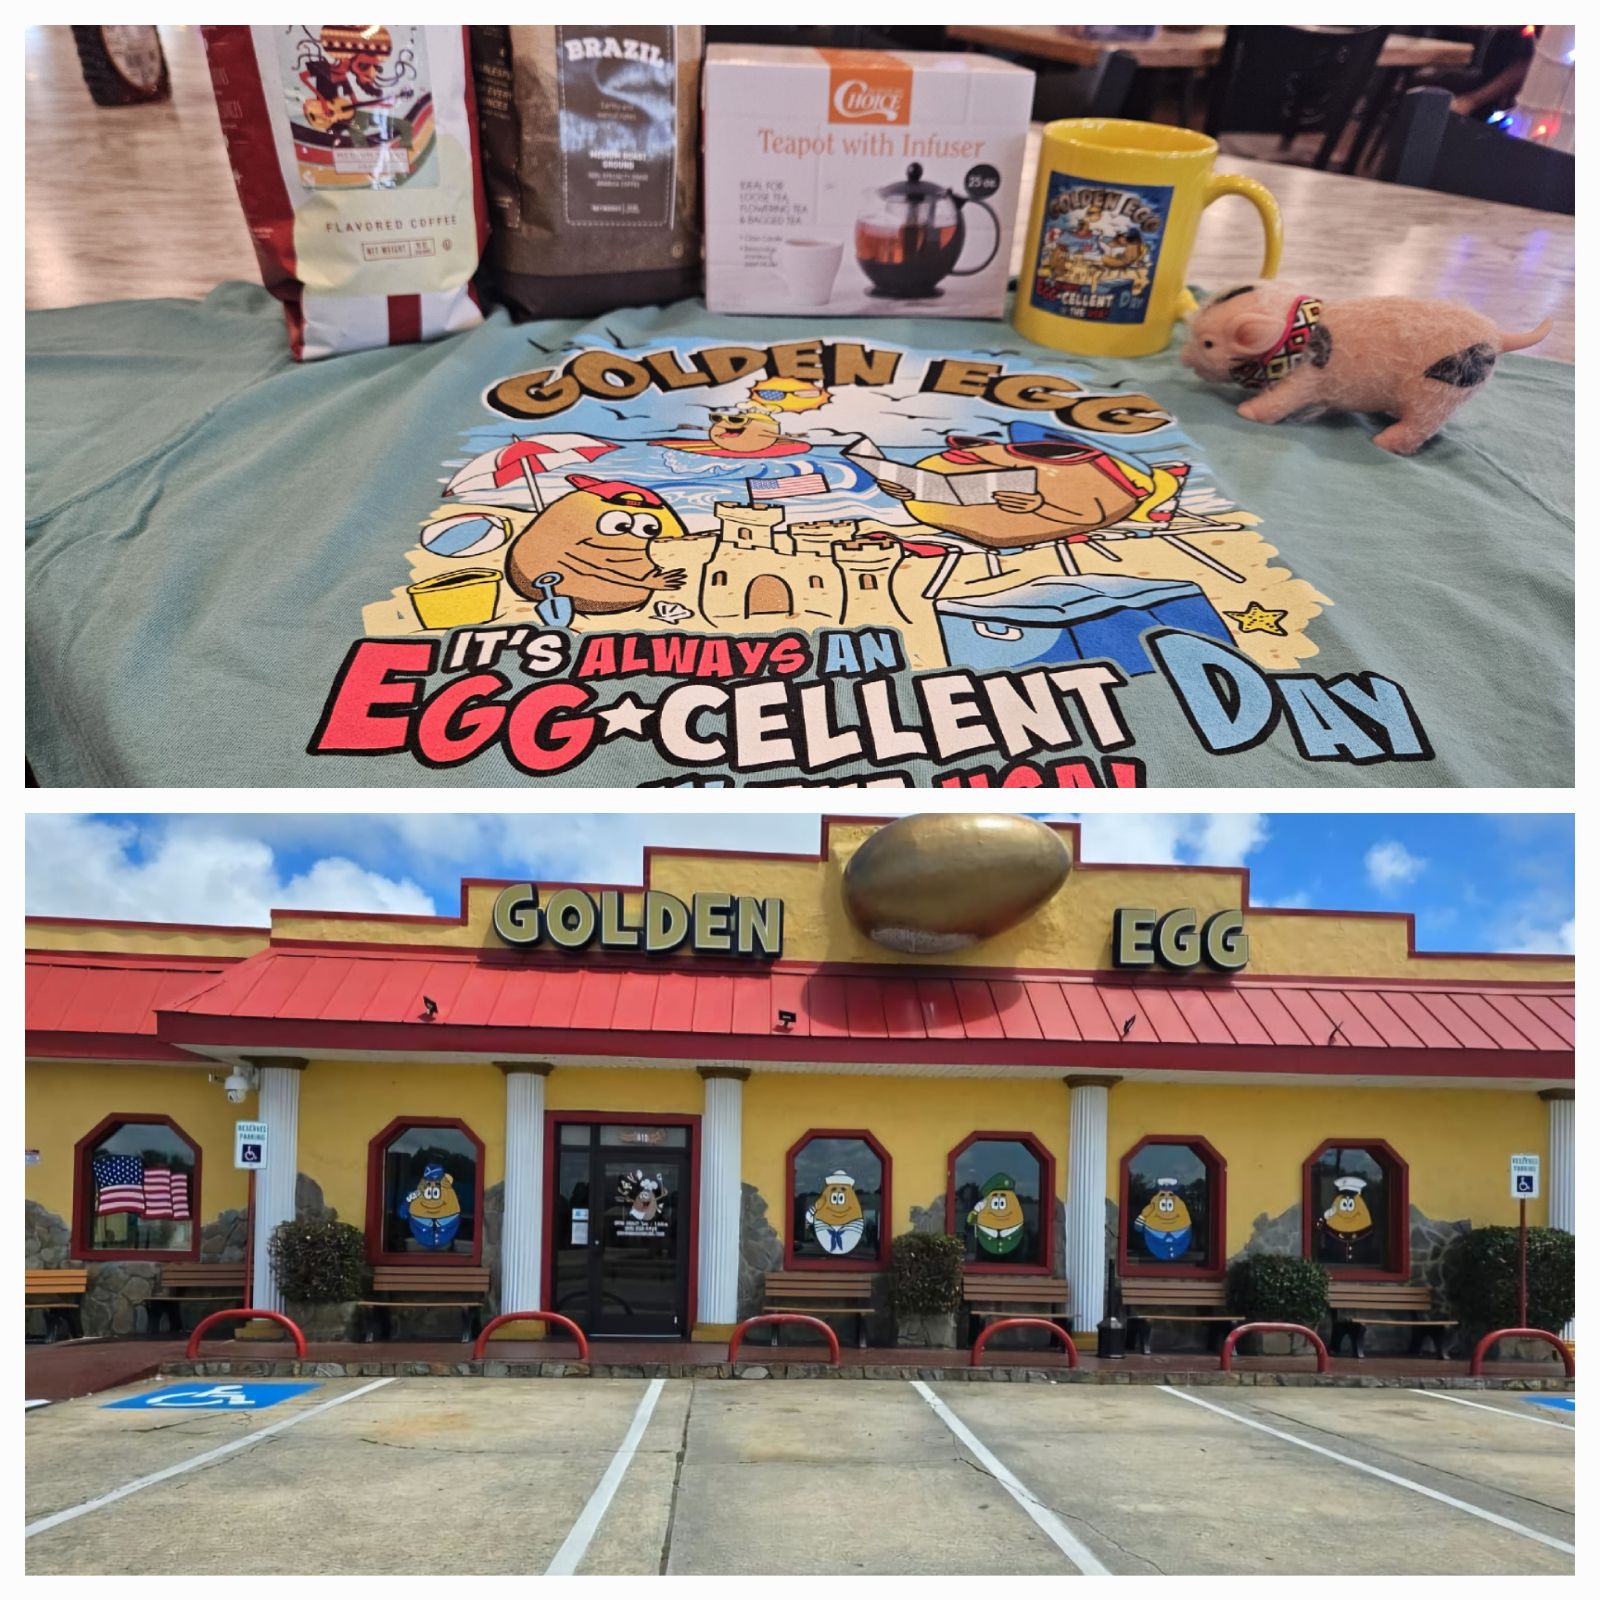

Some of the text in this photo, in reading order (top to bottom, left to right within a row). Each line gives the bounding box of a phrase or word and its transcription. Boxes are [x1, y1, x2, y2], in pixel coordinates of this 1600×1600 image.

[564, 36, 664, 67] BRAZIL
[758, 127, 986, 160] Teapot with Infuser
[766, 181, 784, 191] FOR
[968, 176, 982, 188] 25
[325, 215, 457, 233] FLAVORED COFFEE
[1050, 189, 1161, 232] GOLDEN EGG
[486, 339, 1174, 435] GOLDEN EGG
[441, 625, 906, 681] IT'S ALWAYS AN
[1149, 629, 1436, 763] DAY
[492, 883, 1250, 972] GOLDEN EGG
